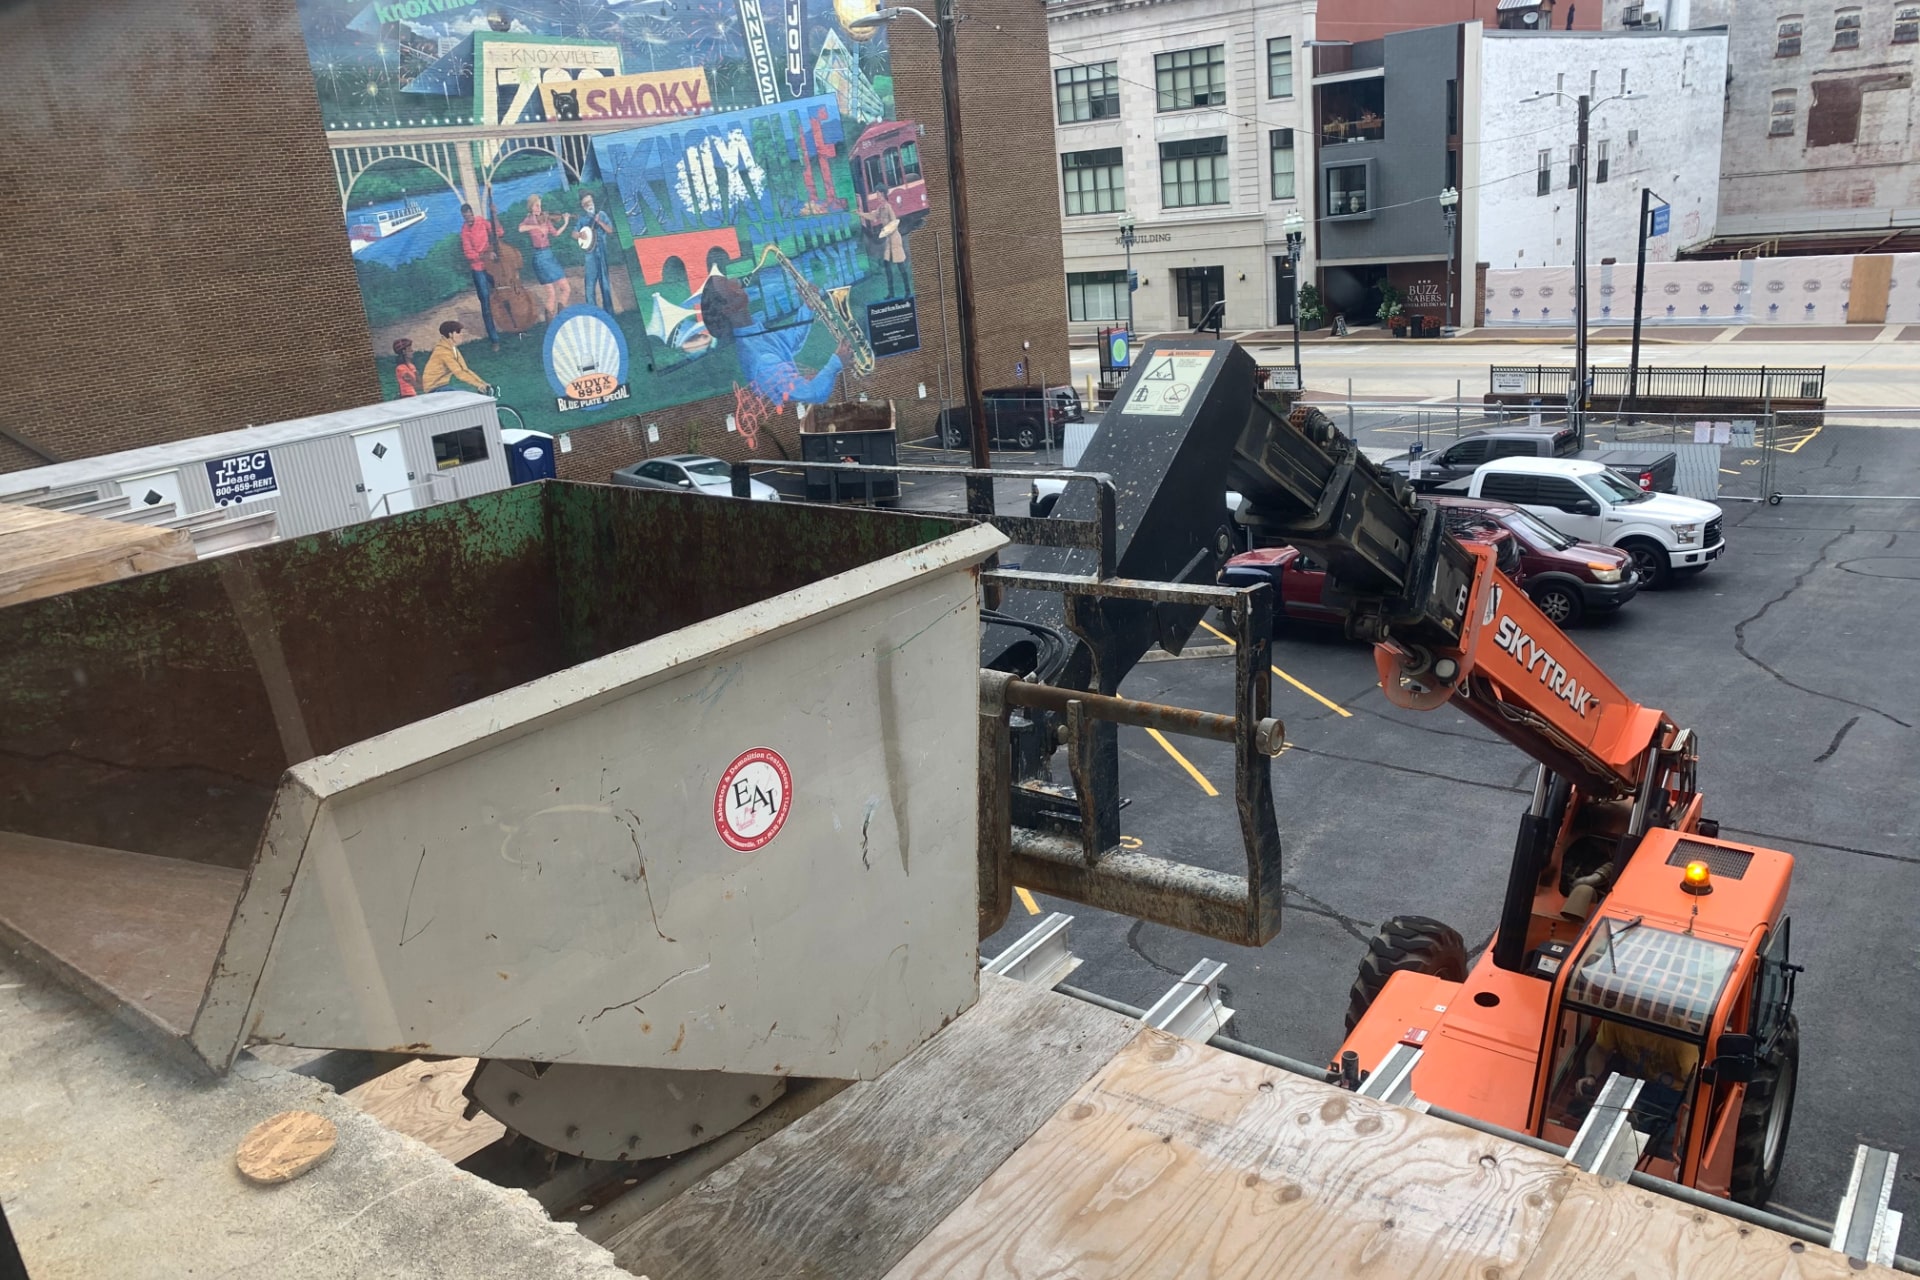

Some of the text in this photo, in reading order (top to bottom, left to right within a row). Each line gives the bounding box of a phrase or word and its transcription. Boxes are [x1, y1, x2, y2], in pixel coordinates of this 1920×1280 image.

[374, 0, 478, 24] knoxv
[510, 48, 601, 64] KNOXVILLE
[586, 79, 702, 117] SMOKY
[1407, 294, 1442, 303] NABERS
[1409, 284, 1439, 295] BUZZ
[571, 376, 612, 391] WDVX
[557, 385, 630, 412] BLUE PLATE SPECIAL
[222, 452, 266, 476] TEG
[215, 476, 273, 497] 800-659-RENT
[1493, 614, 1595, 718] SKYTRAK
[729, 752, 765, 776] Demolition
[766, 753, 790, 790] Contractors
[732, 777, 777, 816] EAI
